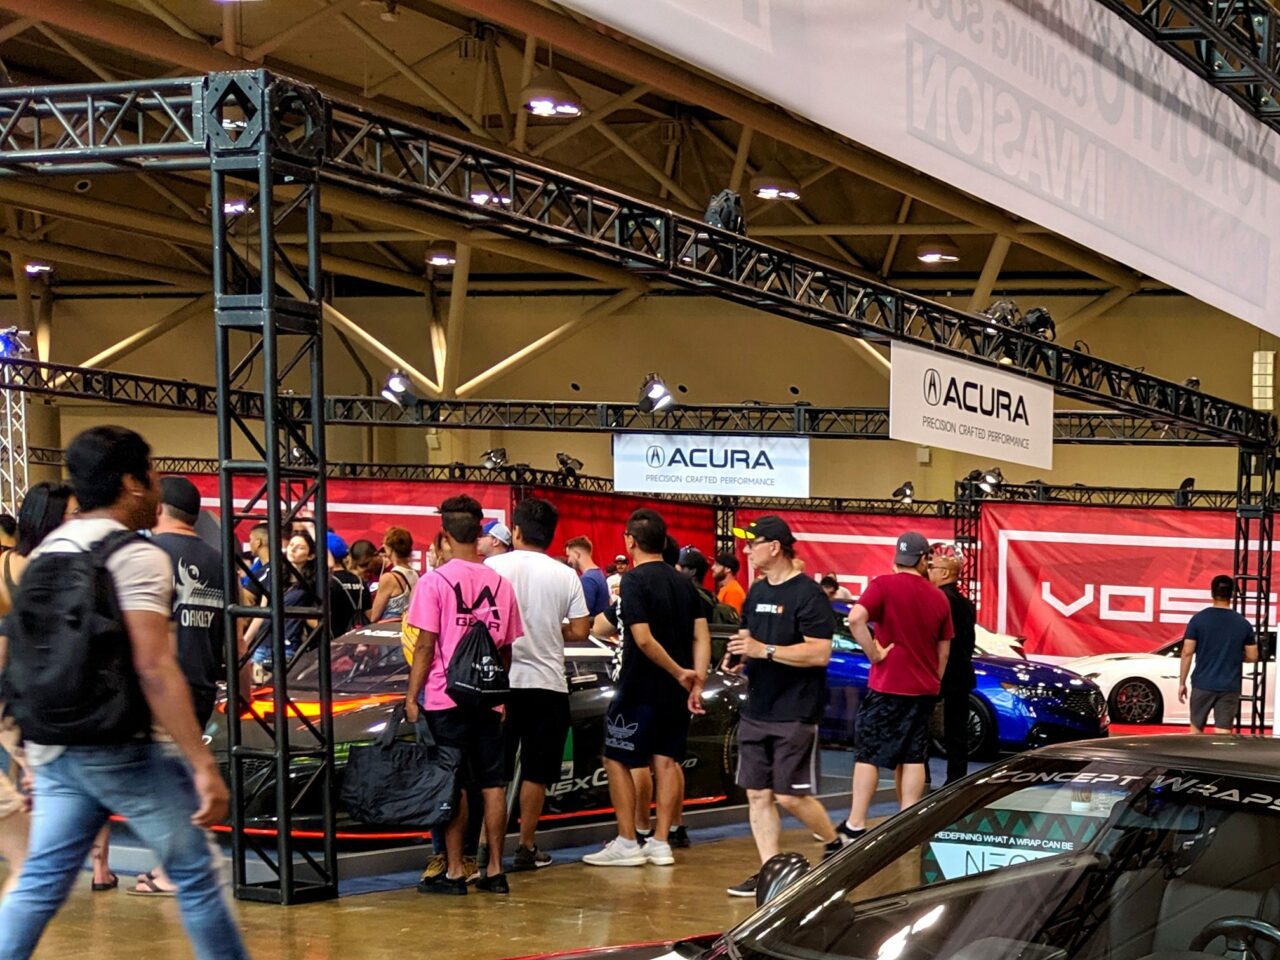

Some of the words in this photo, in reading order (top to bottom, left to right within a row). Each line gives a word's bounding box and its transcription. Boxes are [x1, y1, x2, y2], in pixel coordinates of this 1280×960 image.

[943, 377, 1030, 426] ACURA
[922, 415, 957, 434] PRECISION
[959, 424, 987, 440] CRAFTED
[988, 430, 1030, 450] PERFORMANCE
[667, 447, 775, 470] ACURA
[645, 474, 683, 483] PRECISION
[685, 475, 718, 484] CRAFTED
[720, 476, 775, 486] PERFORMANCE
[454, 581, 501, 620] LA
[181, 609, 215, 628] OAKLEY
[456, 616, 501, 633] GER
[988, 769, 1144, 787] CONCEPT
[934, 831, 983, 842] REDEFINING
[983, 835, 1008, 845] WHAT
[1008, 837, 1016, 845] A
[1016, 838, 1041, 848] WRAP
[1042, 841, 1061, 849] CAN
[1061, 842, 1074, 851] BE
